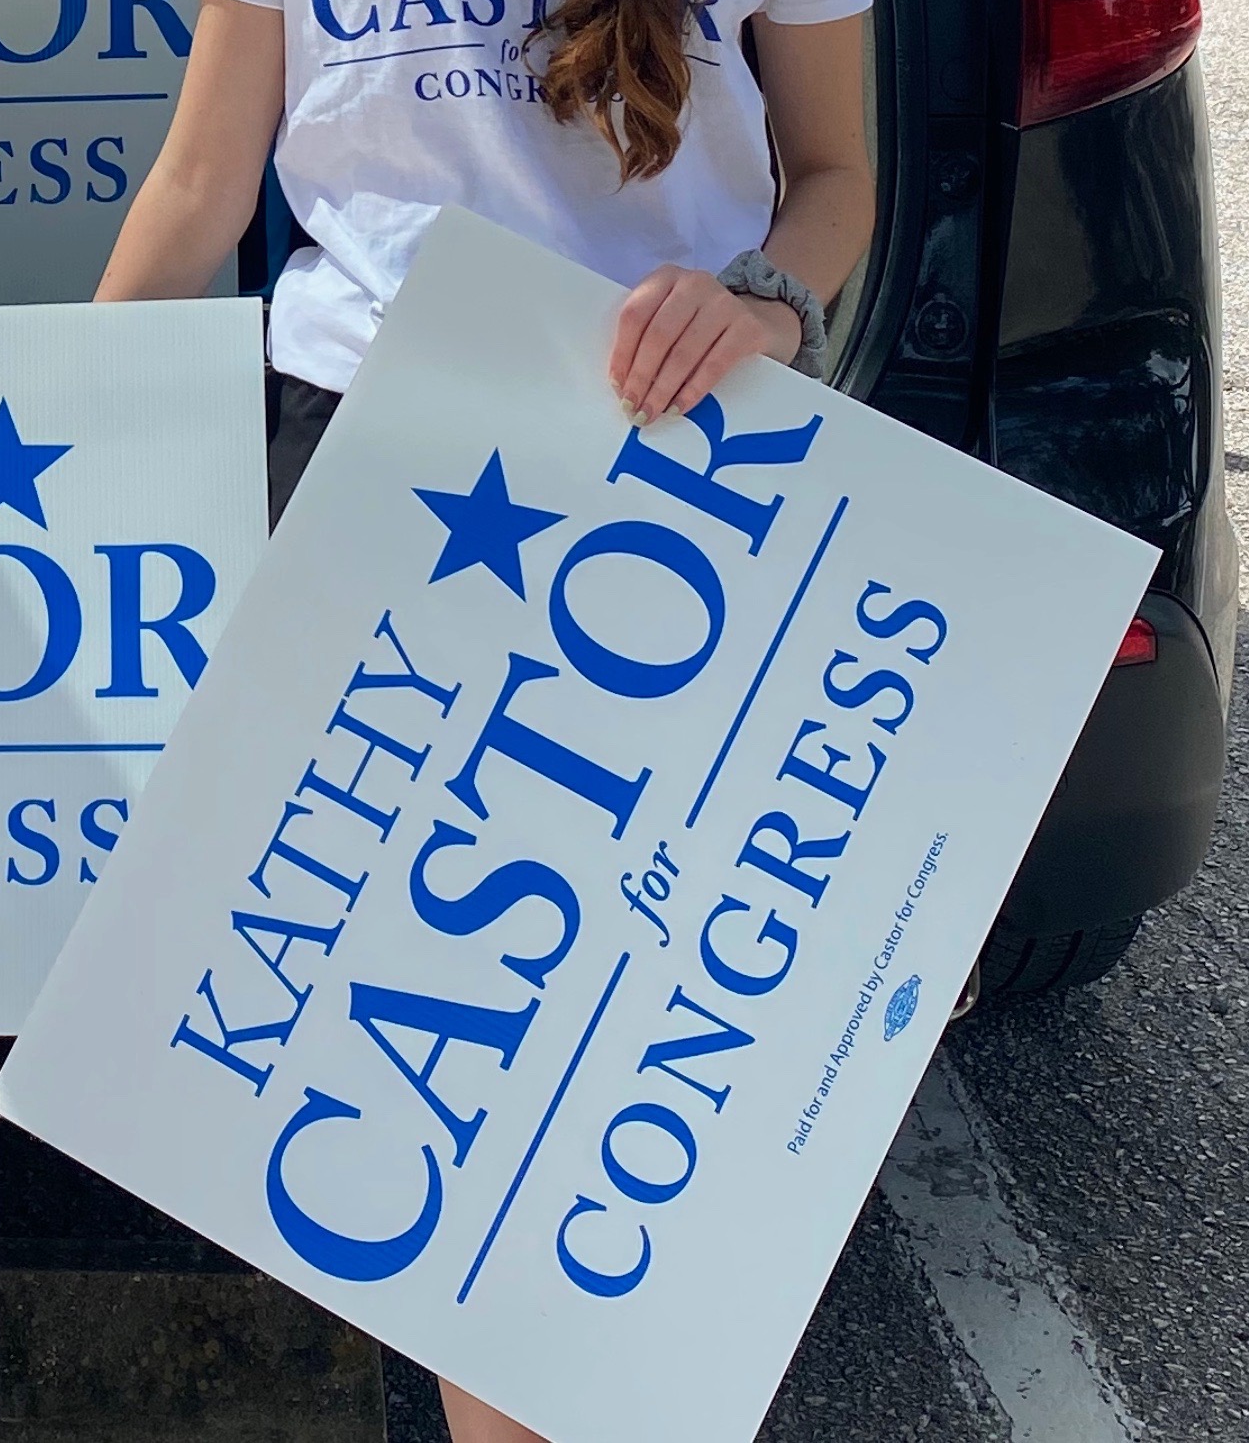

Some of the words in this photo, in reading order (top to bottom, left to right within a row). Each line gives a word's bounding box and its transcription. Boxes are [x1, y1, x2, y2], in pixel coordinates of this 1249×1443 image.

[414, 68, 624, 103] CONGR
[169, 608, 464, 1099] KATHY
[264, 393, 825, 1285] CASTOR
[555, 578, 950, 1300] CONGRESS
[619, 839, 682, 948] for
[787, 1120, 813, 1156] Paid
[803, 1094, 823, 1119] for
[818, 1065, 838, 1097] and
[829, 990, 873, 1067] Approved
[863, 970, 885, 993] by
[874, 922, 905, 971] Castor
[895, 898, 915, 923] for
[907, 831, 950, 900] Congress.
